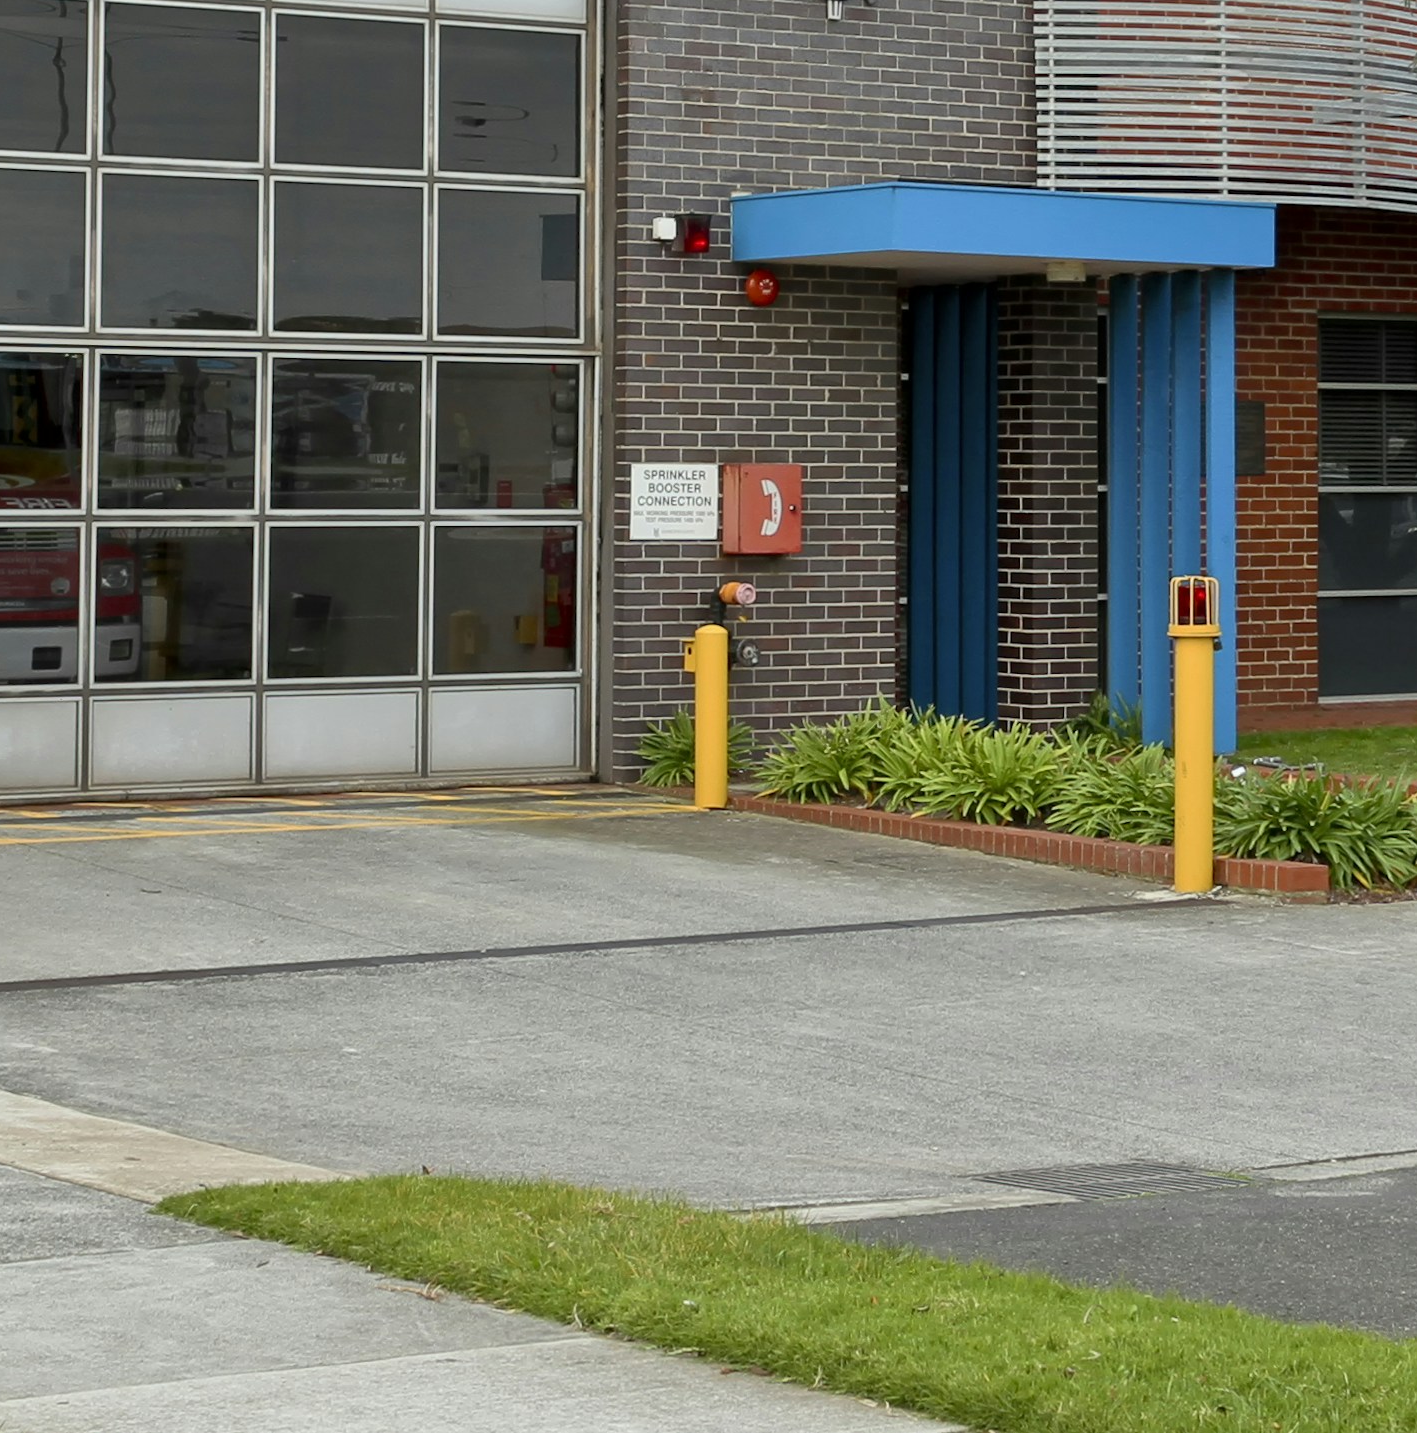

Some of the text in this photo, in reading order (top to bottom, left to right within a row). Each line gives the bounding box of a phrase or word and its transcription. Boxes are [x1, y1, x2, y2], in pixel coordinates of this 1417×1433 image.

[643, 470, 706, 481] SPRINKLER
[648, 482, 701, 494] BOOSTER
[637, 496, 712, 507] CONNECTION
